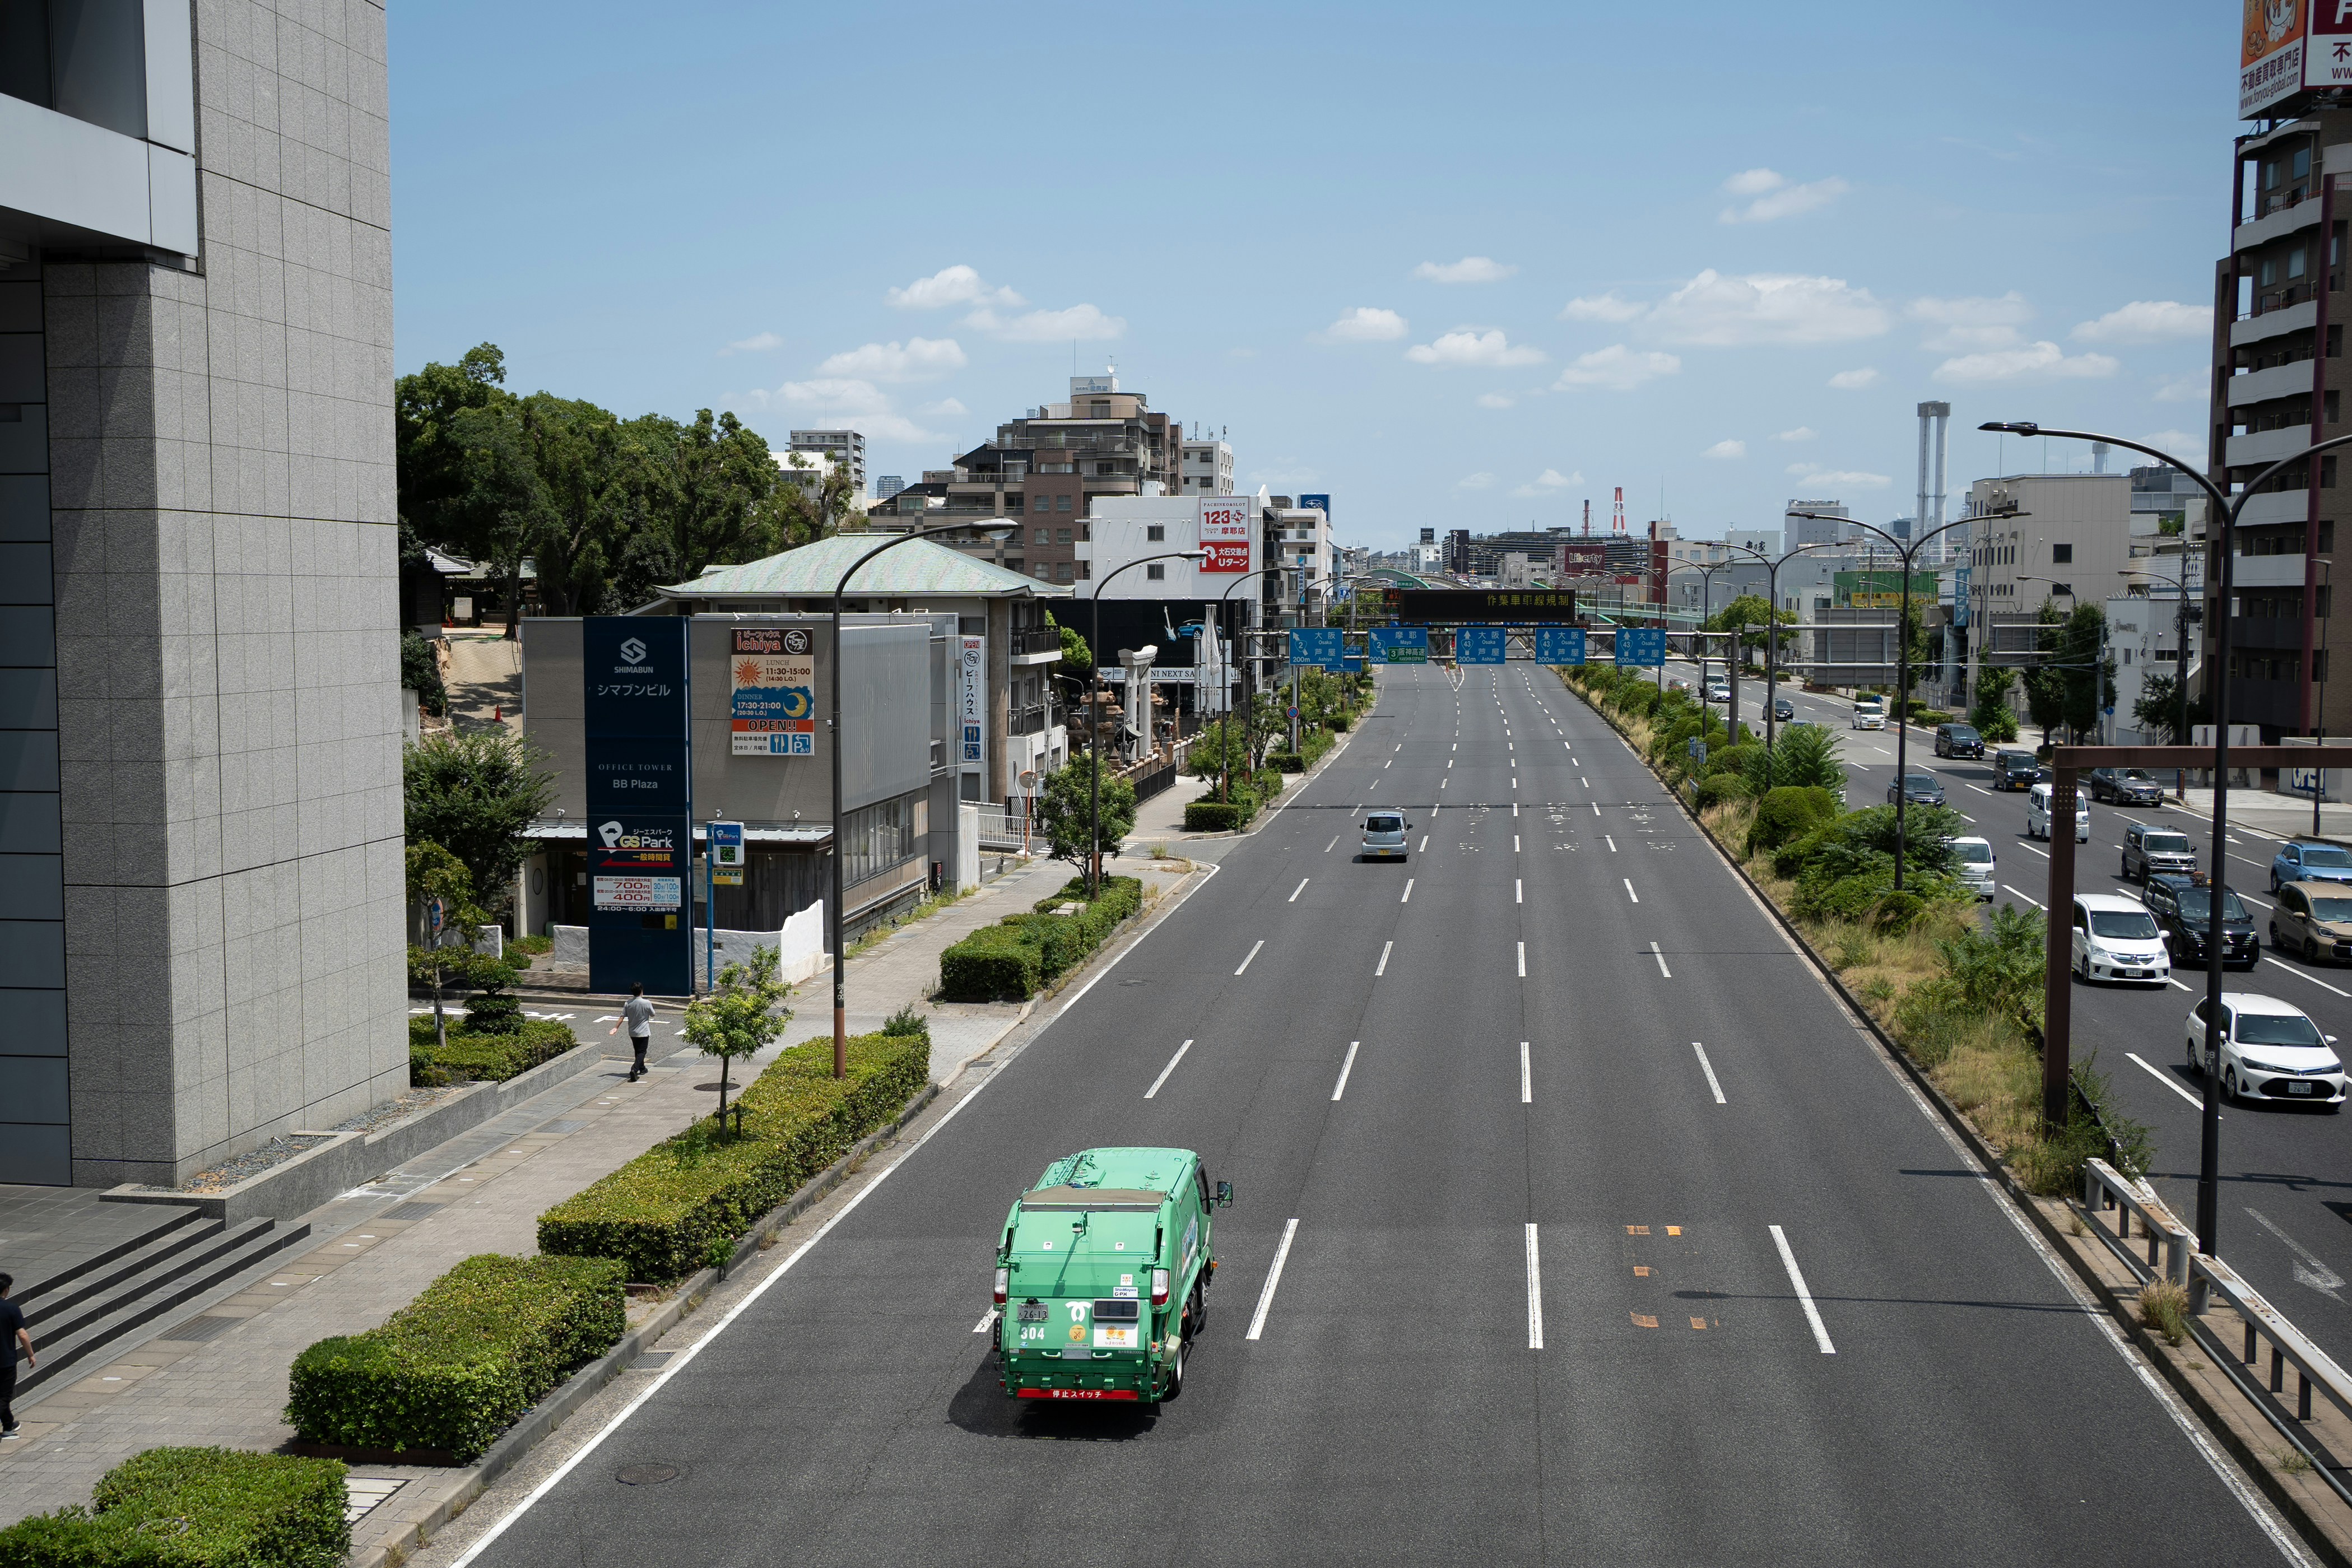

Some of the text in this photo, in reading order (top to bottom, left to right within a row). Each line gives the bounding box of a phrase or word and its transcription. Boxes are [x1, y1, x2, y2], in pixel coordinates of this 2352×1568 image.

[2241, 46, 2300, 94] 不動産買取専門店
[2240, 72, 2298, 110] www.foryou-global.com
[1203, 510, 1230, 524] 123
[1219, 558, 1247, 566] Uターン
[1569, 553, 1602, 565] Liberty
[1478, 631, 1500, 640] 大阪
[1558, 631, 1579, 640] 大阪
[1557, 648, 1579, 657] 芦屋
[1637, 649, 1660, 657] 芦屋
[597, 684, 671, 696] シマブンビル
[966, 669, 974, 715] ビーフハウス
[748, 720, 797, 731] OPEN!!
[613, 780, 658, 789] BB Plaza
[620, 835, 673, 848] GS Park
[633, 853, 671, 862] 一般時間貸
[2205, 1050, 2215, 1059] 28
[1024, 1310, 1047, 1319] 26-13
[1020, 1327, 1045, 1340] 304
[1053, 1390, 1102, 1399] 停止スイッチ
